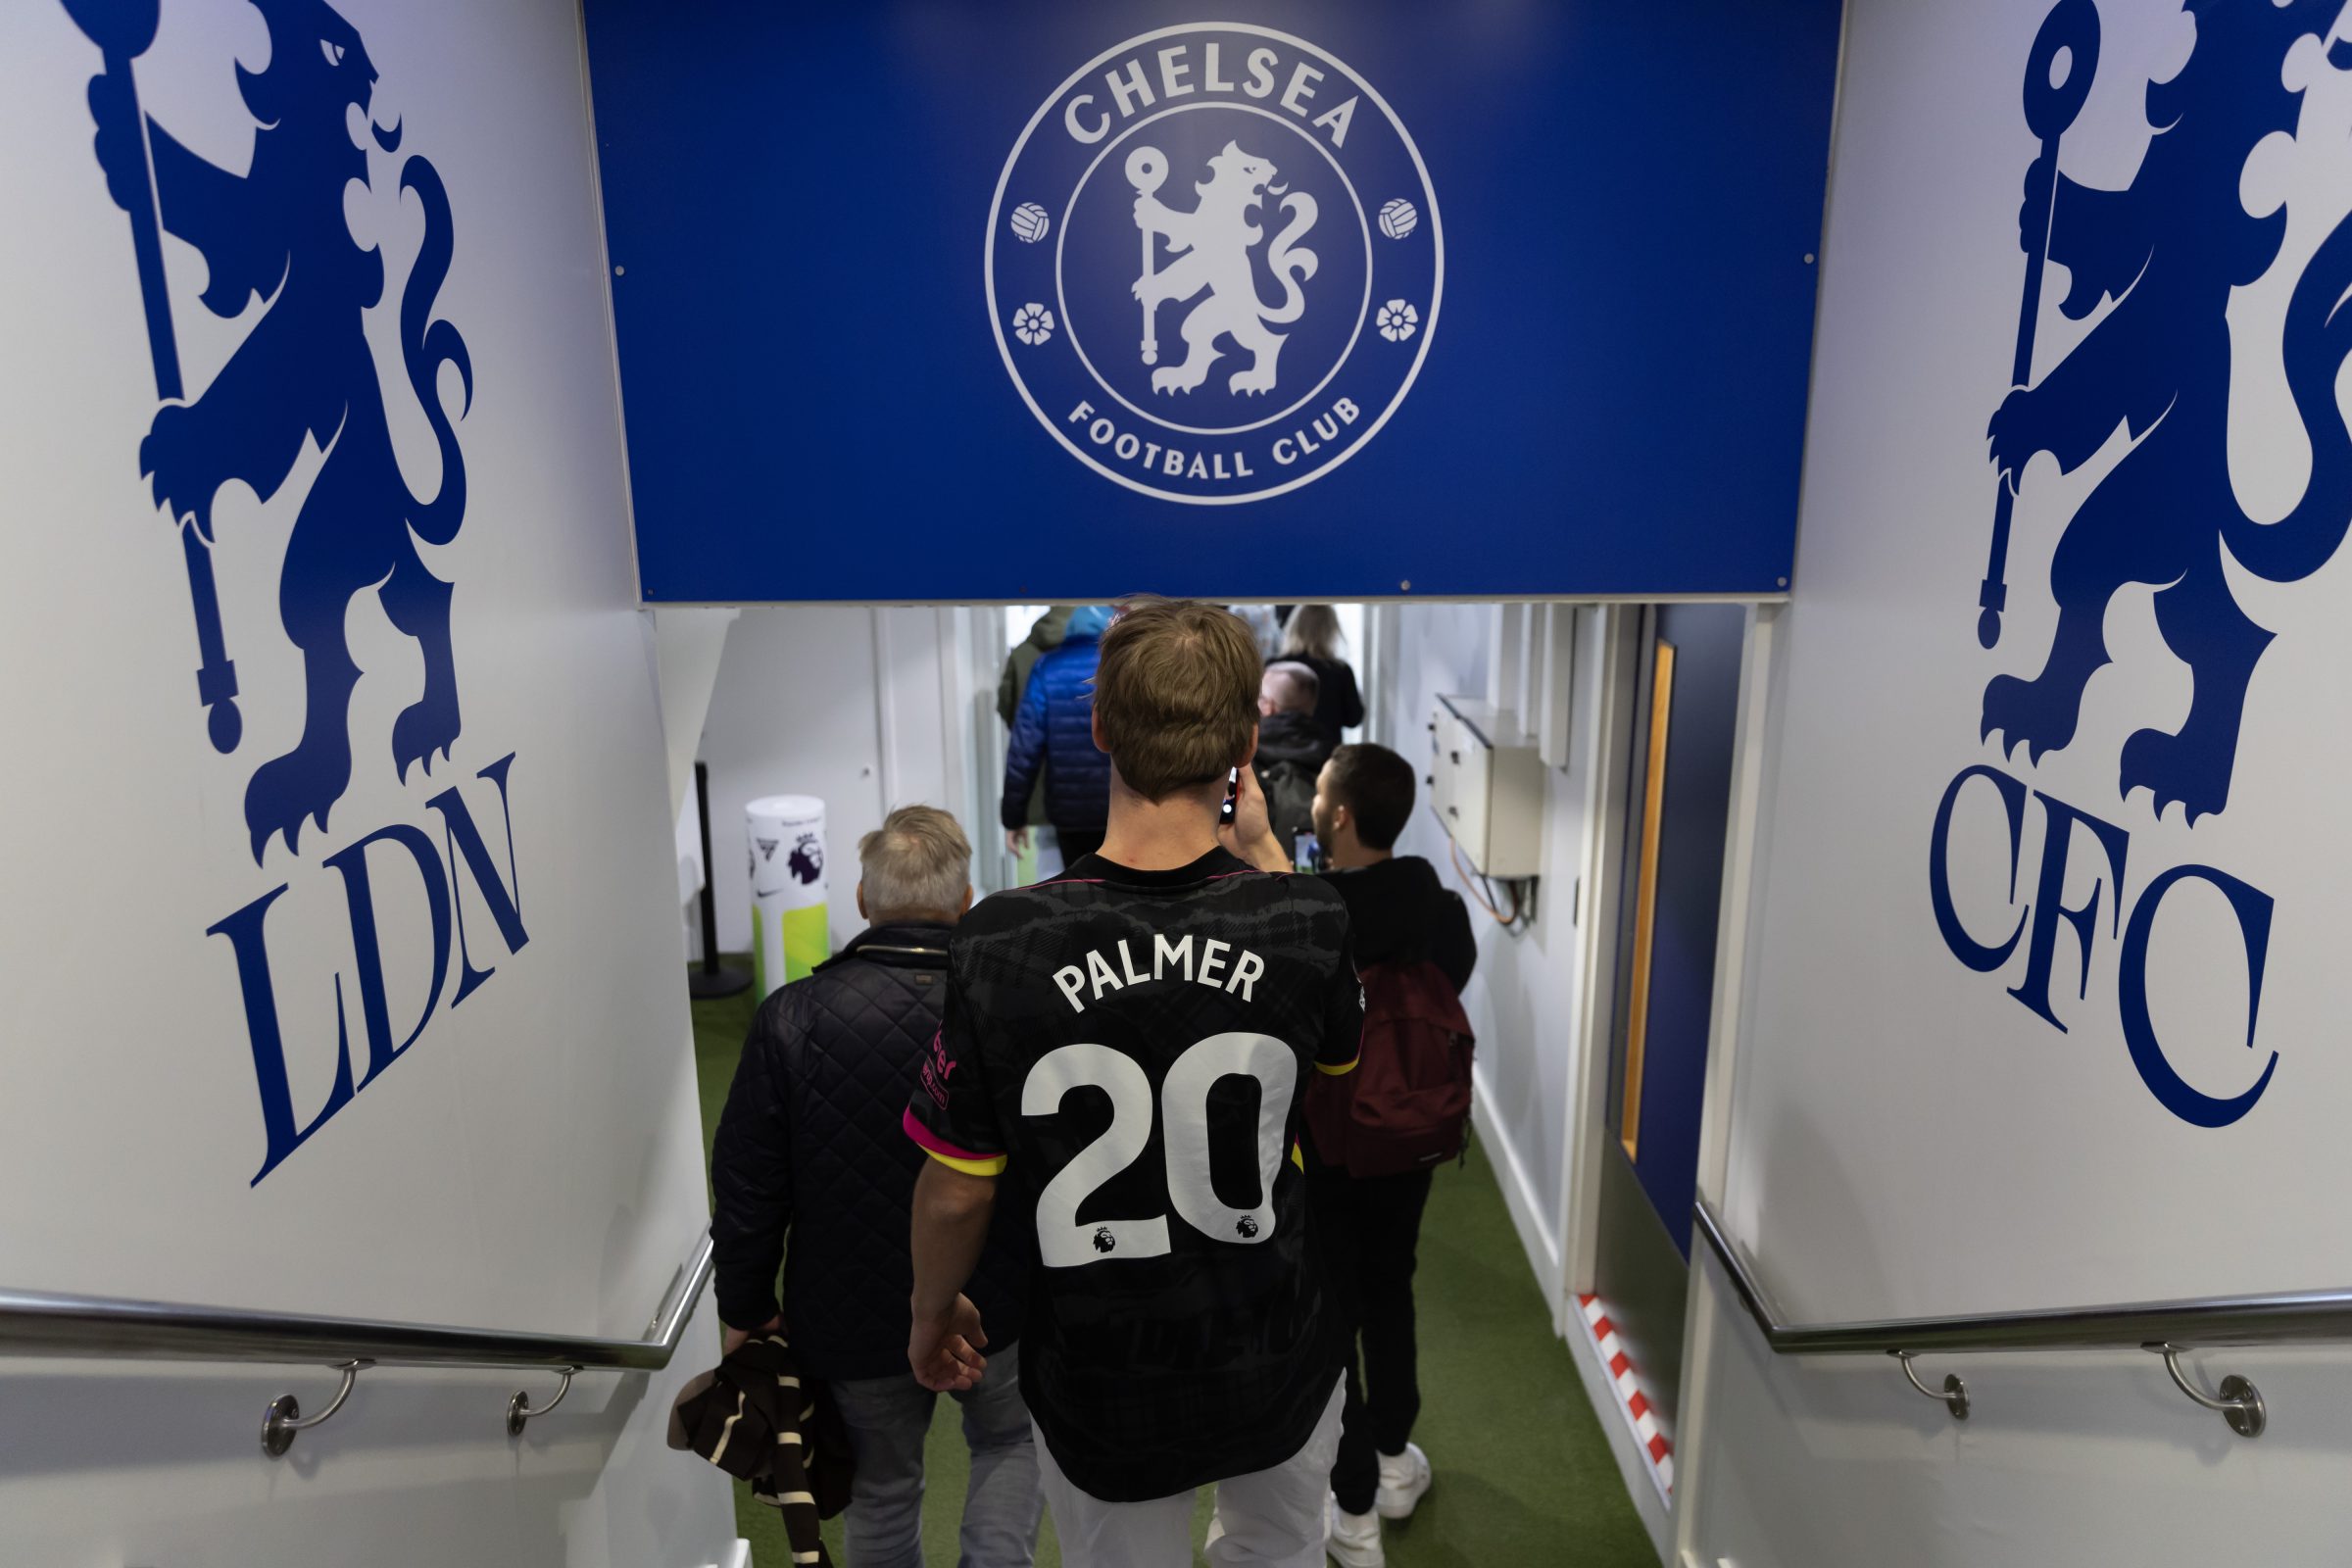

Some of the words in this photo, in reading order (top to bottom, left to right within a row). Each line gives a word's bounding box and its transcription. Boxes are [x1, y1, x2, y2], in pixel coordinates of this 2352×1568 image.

[1064, 42, 1359, 149] CHELSEA
[1068, 400, 1253, 479] FOOTBALL
[1272, 397, 1360, 466] CLUB
[206, 751, 530, 1189] LDN
[1052, 933, 1265, 1013] PALMER
[1929, 764, 2279, 1129] CFC
[1021, 1031, 1298, 1268] 20
